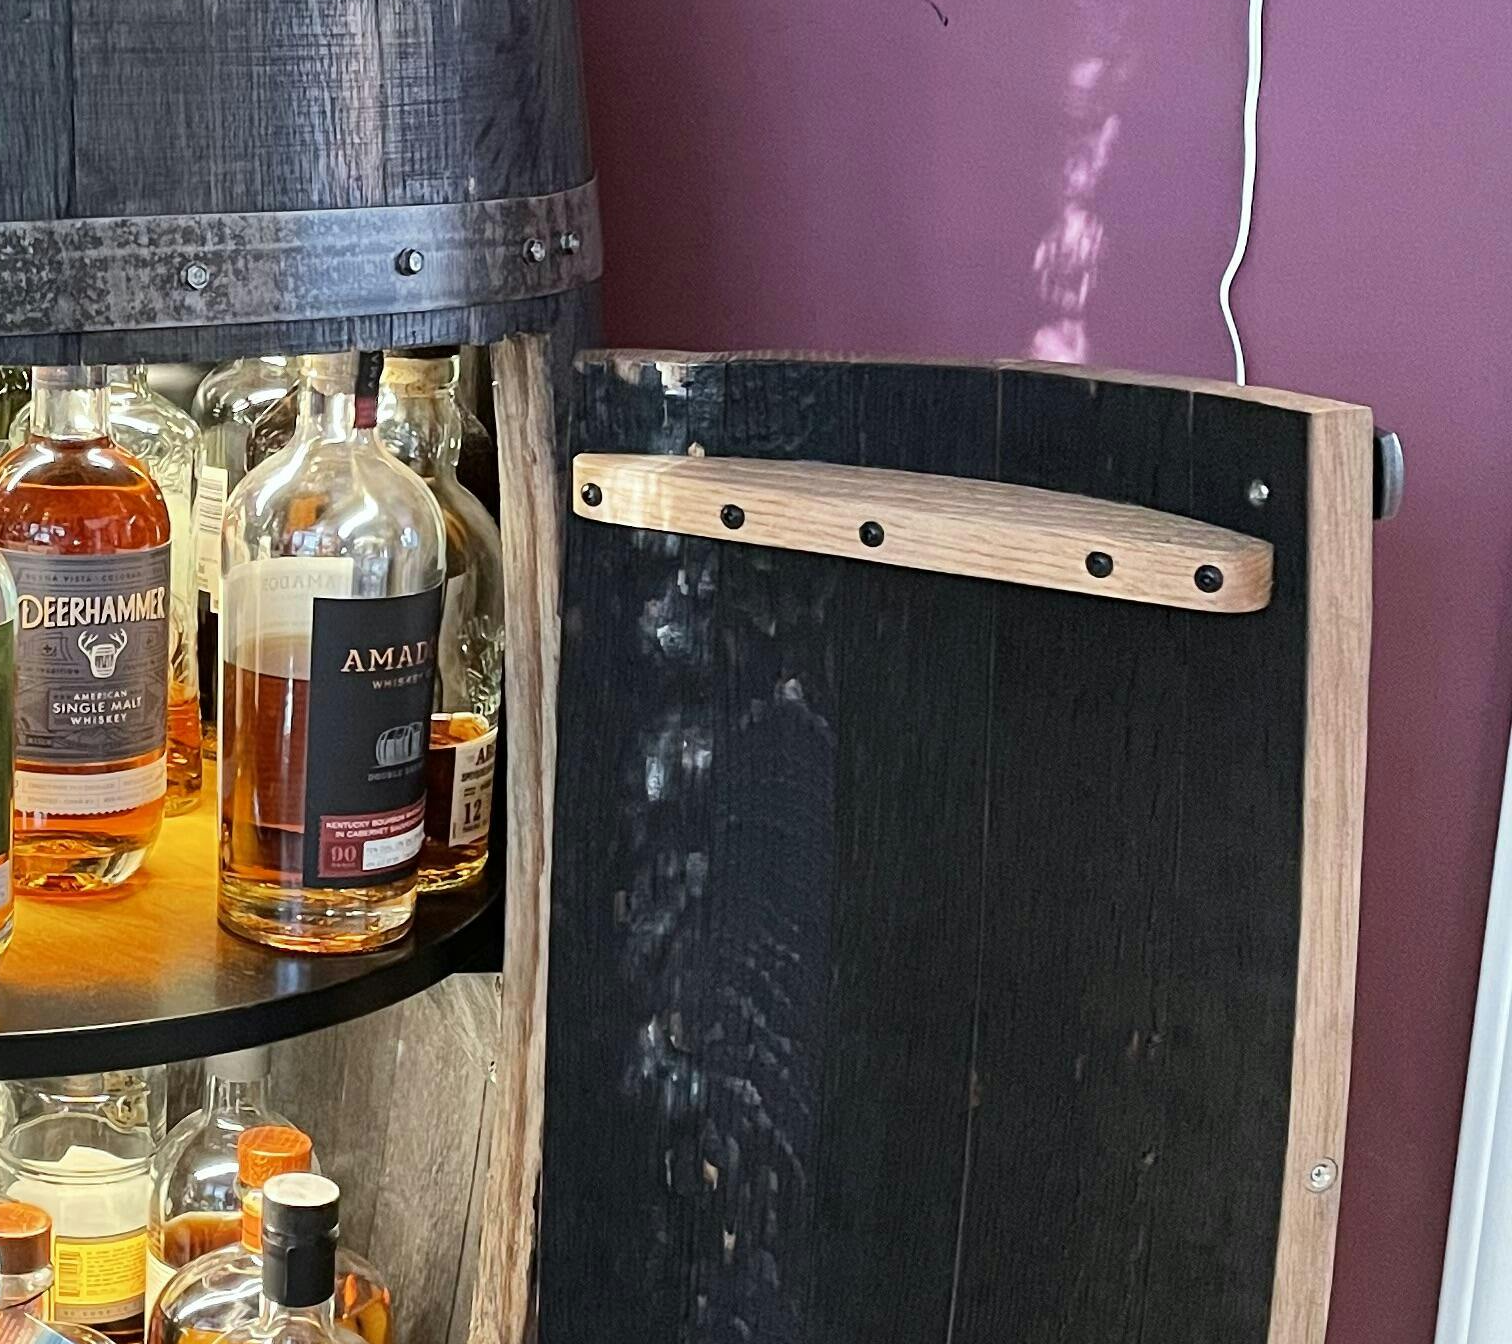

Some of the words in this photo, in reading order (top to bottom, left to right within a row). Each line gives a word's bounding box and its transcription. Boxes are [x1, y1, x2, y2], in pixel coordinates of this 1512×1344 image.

[17, 586, 166, 629] DEERHAMMER
[340, 641, 429, 673] AMAD
[74, 690, 128, 701] AMERICAN
[52, 702, 105, 714] SINGLE
[111, 696, 142, 710] MALT
[70, 713, 127, 725] WHISKEY
